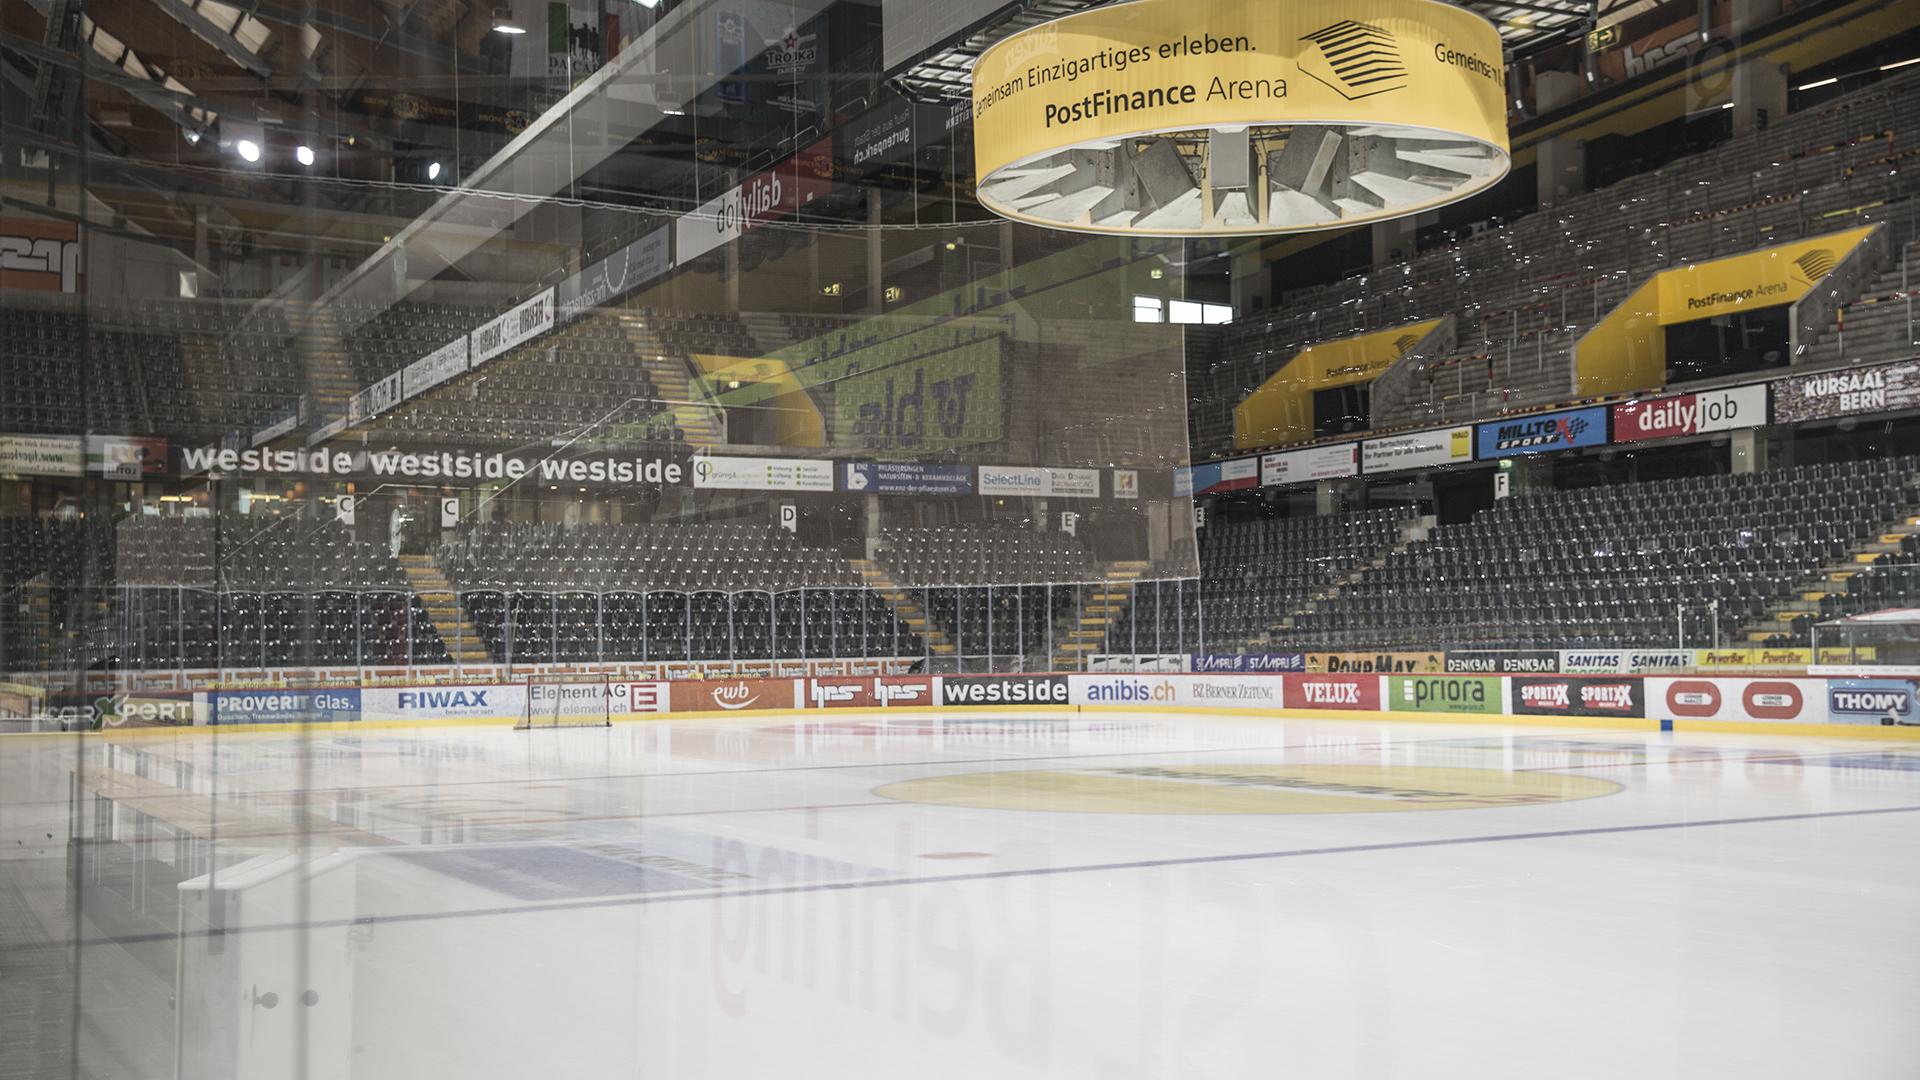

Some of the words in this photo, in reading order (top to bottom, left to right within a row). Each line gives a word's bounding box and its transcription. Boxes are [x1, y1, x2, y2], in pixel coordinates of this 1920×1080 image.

[1027, 43, 1151, 89] Einzigartiges
[1159, 33, 1258, 63] erleben.
[1045, 83, 1196, 128] PostFinance
[1206, 77, 1288, 102] Arena
[1687, 289, 1753, 310] PostFinance
[1756, 281, 1788, 295] Arena
[1804, 371, 1885, 397] KURSAAL
[1839, 389, 1885, 411] BERN
[1700, 393, 1738, 428] job
[1498, 434, 1555, 451] SPORT
[182, 446, 352, 475] westside
[370, 450, 526, 480] westside
[541, 456, 684, 486] westside
[983, 471, 1042, 488] SelectLine
[1497, 475, 1508, 491] F
[444, 500, 456, 515] C
[783, 508, 794, 521] D
[1064, 513, 1073, 527] E
[1567, 655, 1619, 667] SANITAS
[1631, 655, 1688, 667] SANITAS
[1706, 652, 1746, 664] PowerBar
[1762, 651, 1803, 664] PowerBar
[399, 690, 489, 709] RIWAX
[531, 686, 597, 701] Element
[712, 681, 749, 700] ewb
[944, 680, 1067, 701] westside
[1088, 680, 1175, 701] anibis.ch
[1303, 683, 1357, 703] VELUX
[1415, 680, 1484, 707] priora
[315, 694, 355, 711] Glas.
[1834, 693, 1907, 710] THOMY
